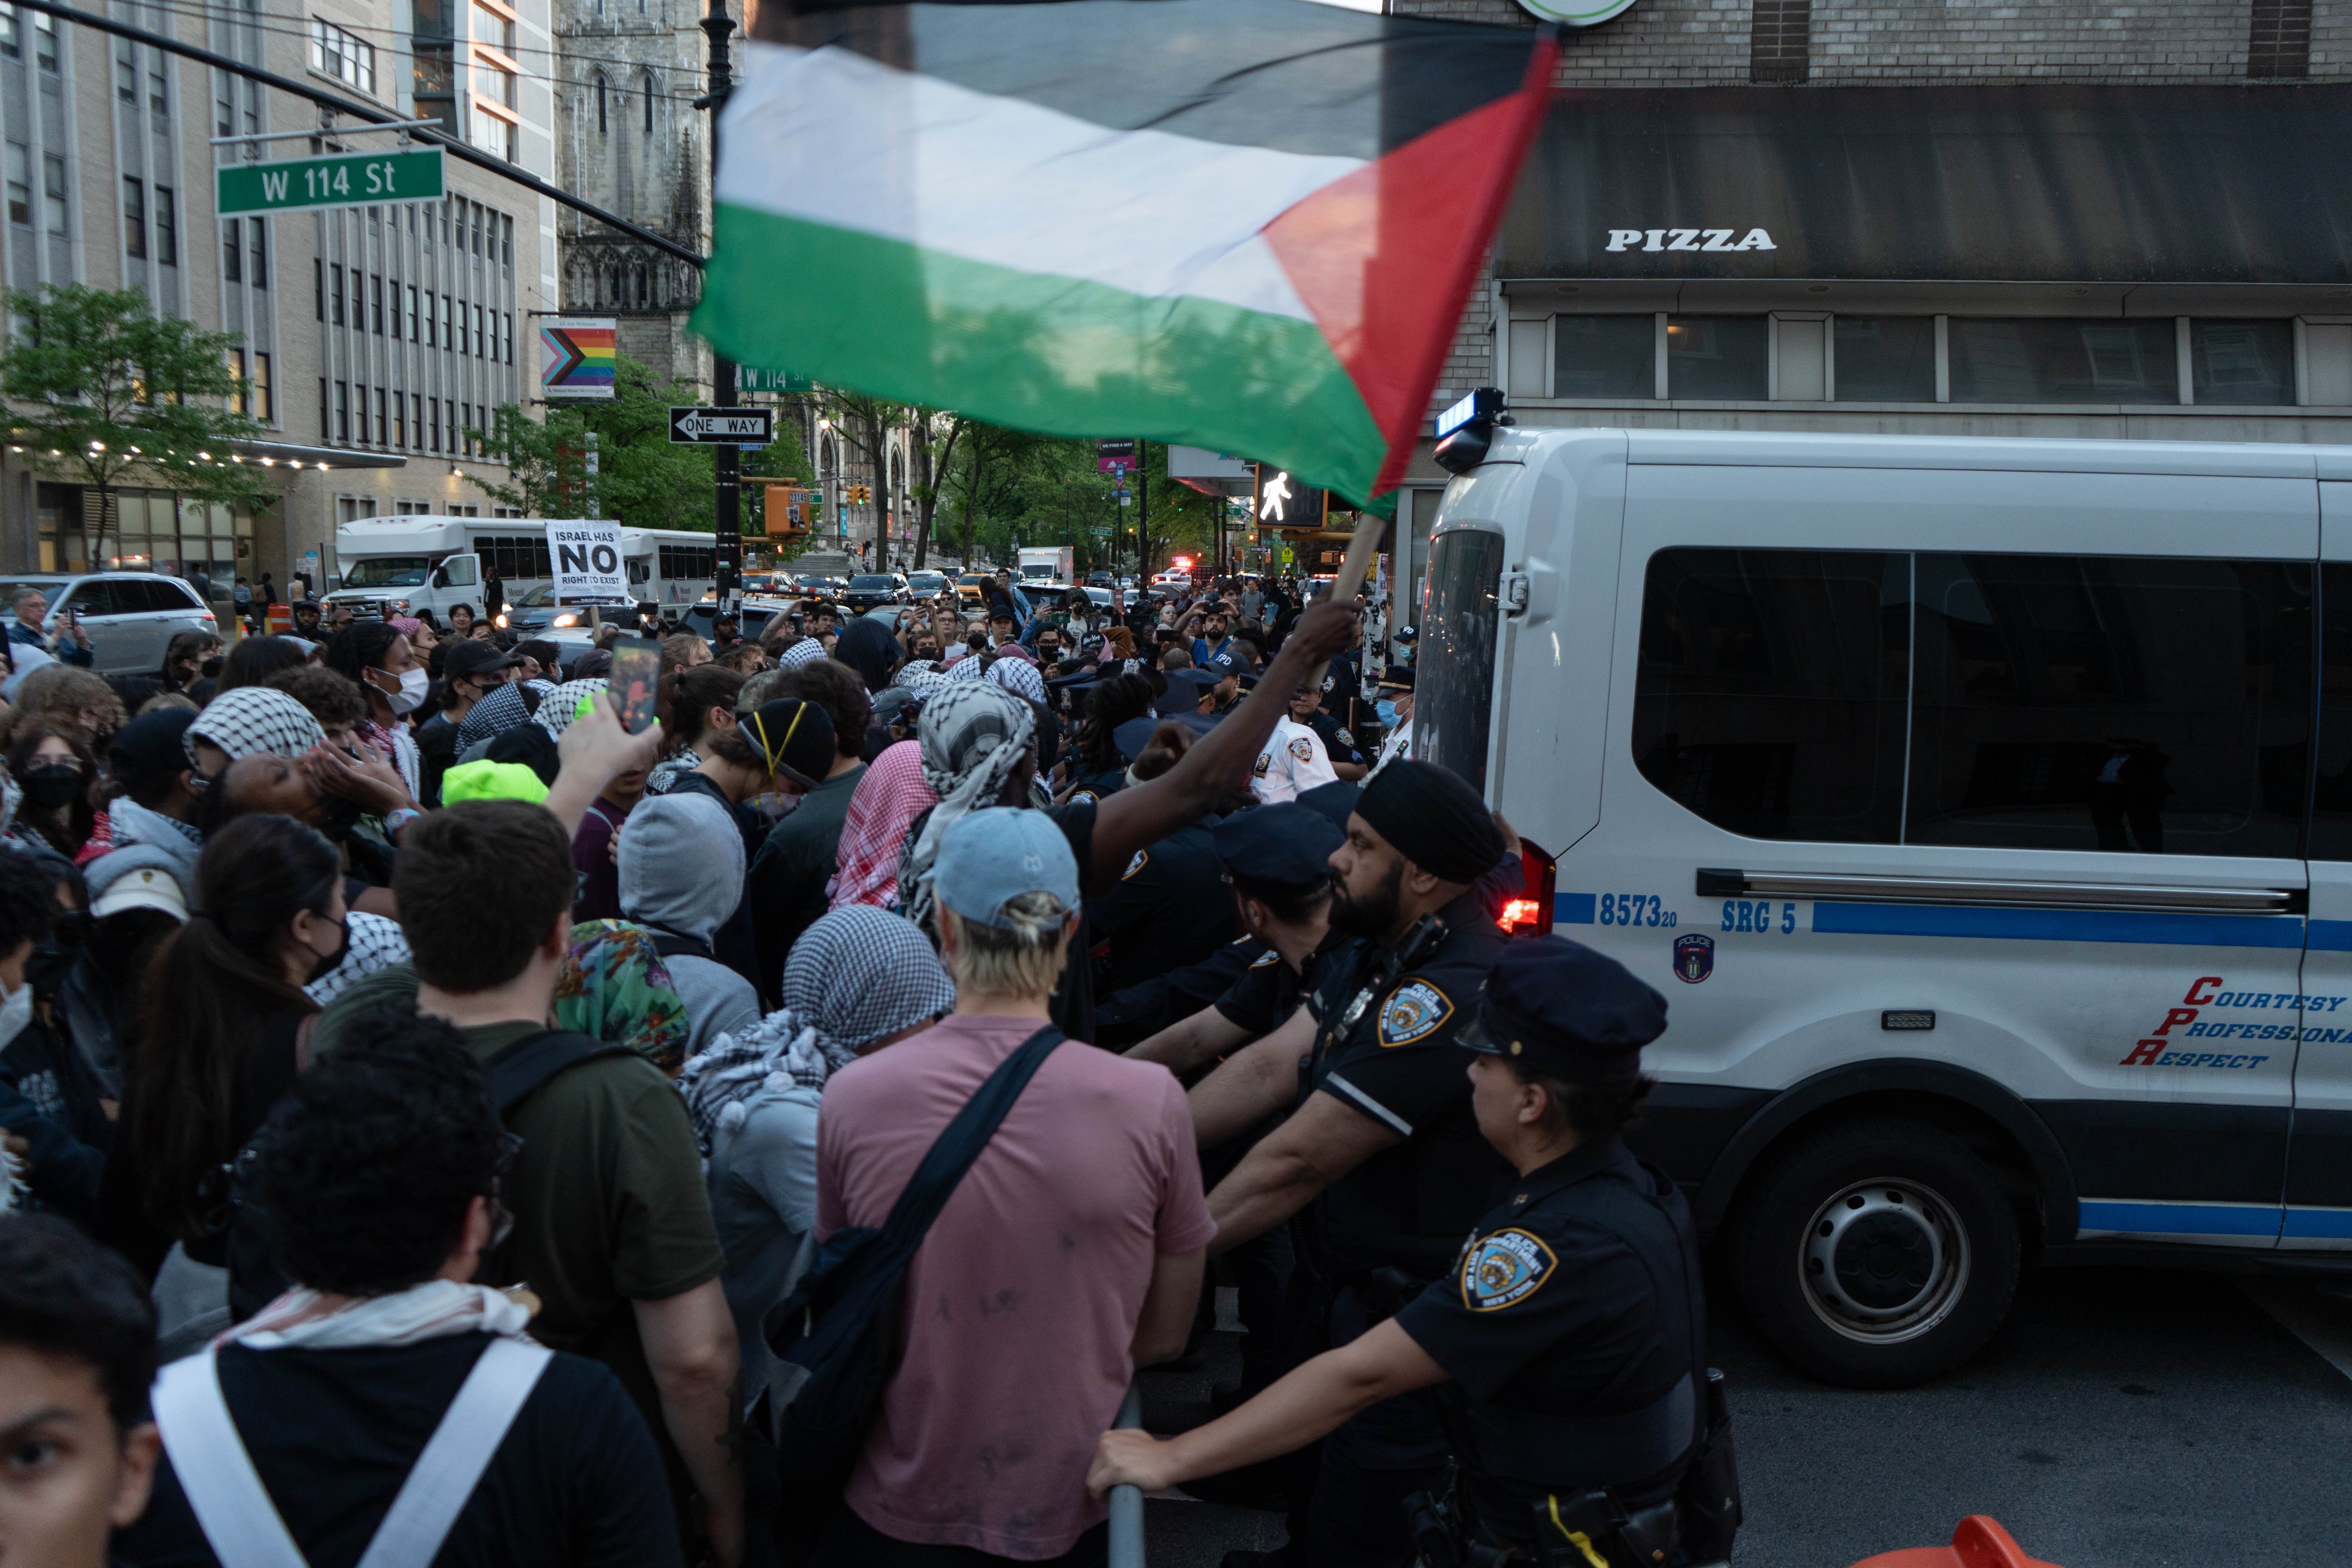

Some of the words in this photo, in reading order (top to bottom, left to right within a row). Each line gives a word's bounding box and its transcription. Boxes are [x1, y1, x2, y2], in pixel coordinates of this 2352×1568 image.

[262, 170, 289, 202] W
[304, 166, 351, 198] 114
[366, 161, 396, 194] St
[1605, 229, 1777, 251] PIZZA
[747, 368, 757, 388] W
[766, 369, 786, 388] 114
[686, 419, 713, 432] ONE
[728, 419, 757, 432] WAY
[790, 493, 807, 503] 23145
[556, 531, 592, 541] ISRAEL
[594, 533, 614, 542] HAS
[558, 544, 617, 574] NO
[508, 588, 524, 596] Mount
[1600, 893, 1661, 927] 8573
[1661, 911, 1677, 927] 20
[1721, 900, 1770, 933] SRG
[1781, 903, 1795, 934] 5
[1678, 936, 1711, 948] POLICE
[1398, 988, 1442, 1018] DEPARTMENT
[1412, 983, 1439, 1002] POLICE
[1383, 999, 1394, 1016] CITY
[1382, 1018, 1388, 1029] OF
[1392, 1032, 1412, 1042] NEW
[1412, 1021, 1435, 1035] YORK
[1504, 1233, 1539, 1256] POLICE
[1468, 1251, 1480, 1273] CITY
[1485, 1237, 1543, 1275] DEPARTMENT
[1483, 1295, 1506, 1307] NEW
[1506, 1280, 1536, 1300] YORK
